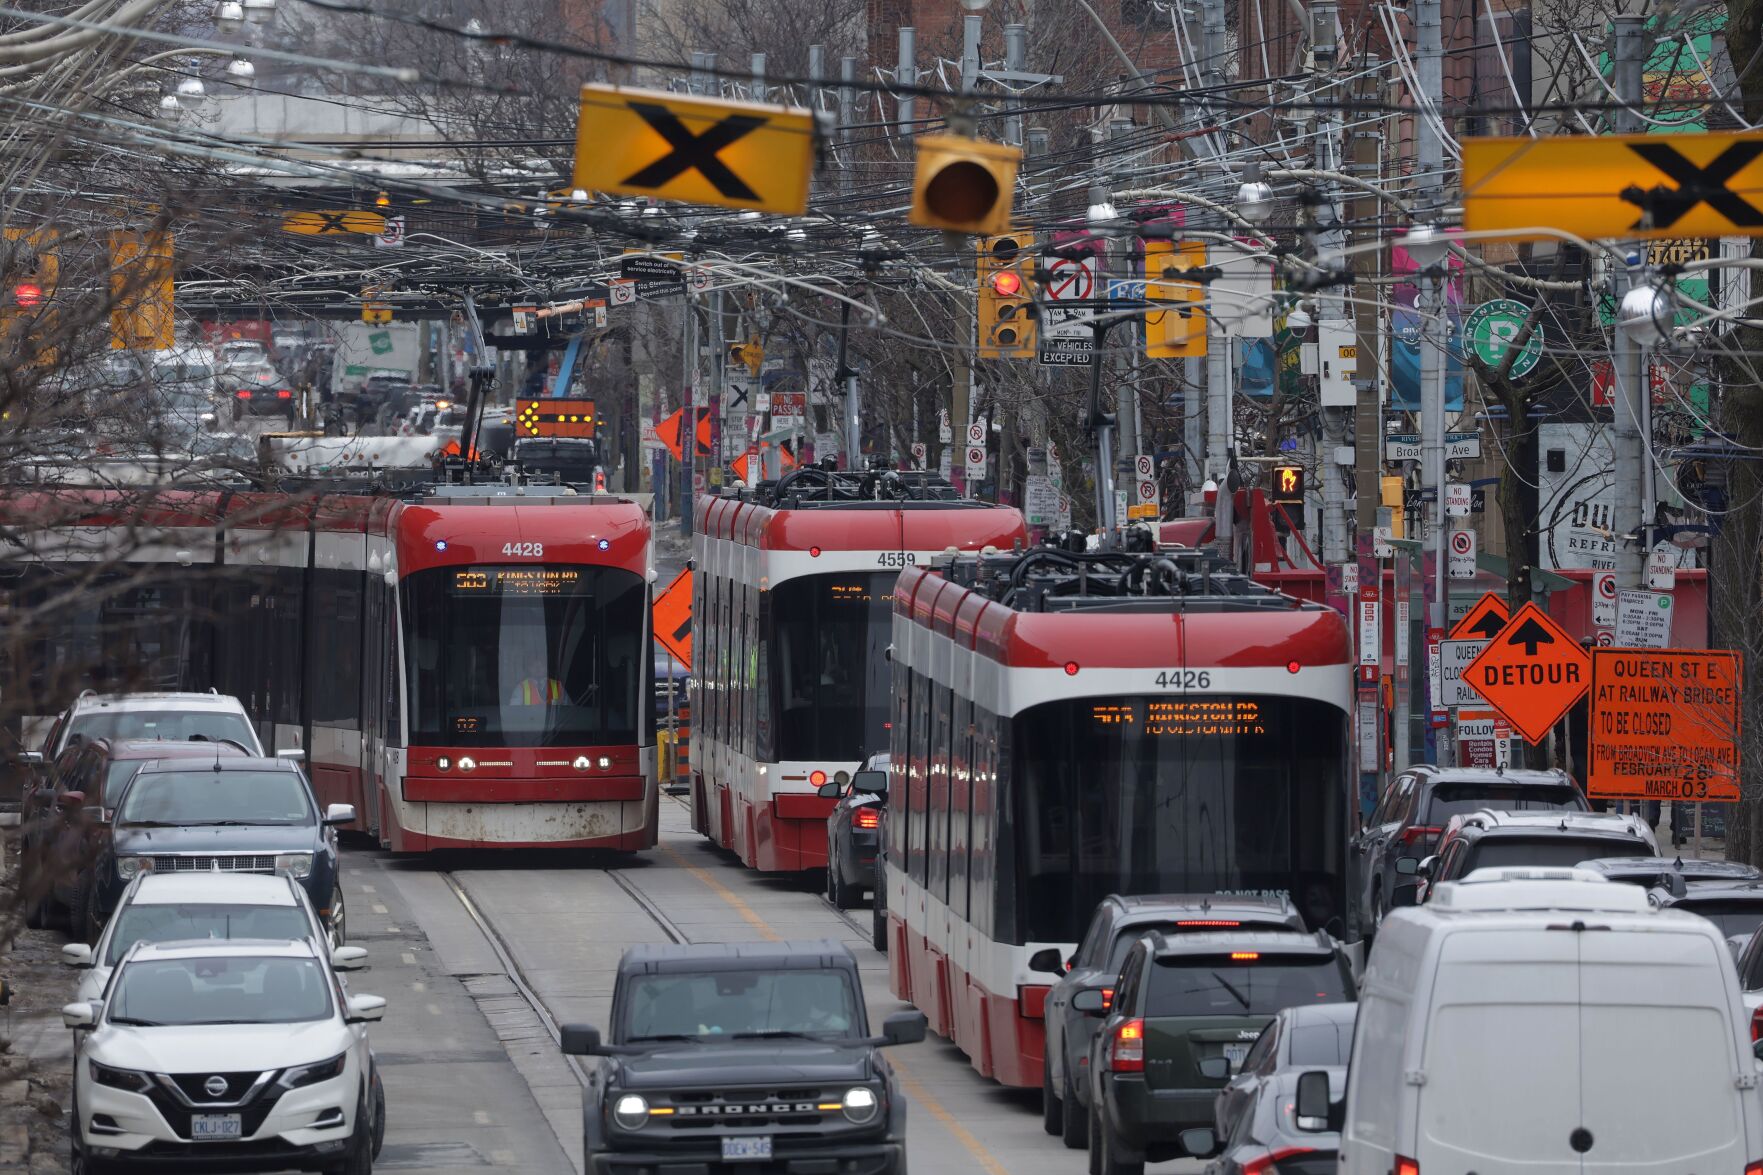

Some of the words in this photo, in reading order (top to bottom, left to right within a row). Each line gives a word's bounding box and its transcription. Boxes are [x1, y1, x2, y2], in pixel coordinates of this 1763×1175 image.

[1057, 342, 1092, 350] VEHICLES
[1044, 352, 1090, 362] EXCEPTED
[1452, 445, 1470, 455] Ave
[1454, 488, 1462, 496] NO
[1446, 497, 1468, 506] STANDING
[502, 542, 544, 557] 4428
[878, 552, 916, 567] 4559
[1650, 566, 1673, 575] STANDING
[1484, 662, 1580, 686] DETOUR
[1614, 660, 1673, 678] QUEEN
[1680, 662, 1700, 678] ST
[1707, 662, 1717, 680] E
[1155, 671, 1210, 689] 4426
[1598, 685, 1615, 701] AT
[1620, 686, 1679, 704] RAILWAY
[1684, 687, 1732, 705] BRIDGE
[1600, 711, 1612, 734] TO
[1616, 712, 1629, 734] BE
[1632, 712, 1672, 736] CLOSED
[1596, 744, 1616, 760] FROM
[1618, 745, 1660, 761] BROADVIEW
[1662, 746, 1677, 762] AVE
[1679, 746, 1690, 762] TO
[1690, 746, 1714, 764] LOGAN
[1718, 748, 1732, 764] AVE
[1614, 762, 1681, 778] FEBRUARY
[1646, 780, 1678, 795] MARCH
[1682, 782, 1707, 798] 03
[1237, 1030, 1260, 1039] Jeep
[679, 1103, 814, 1114] BRONCO
